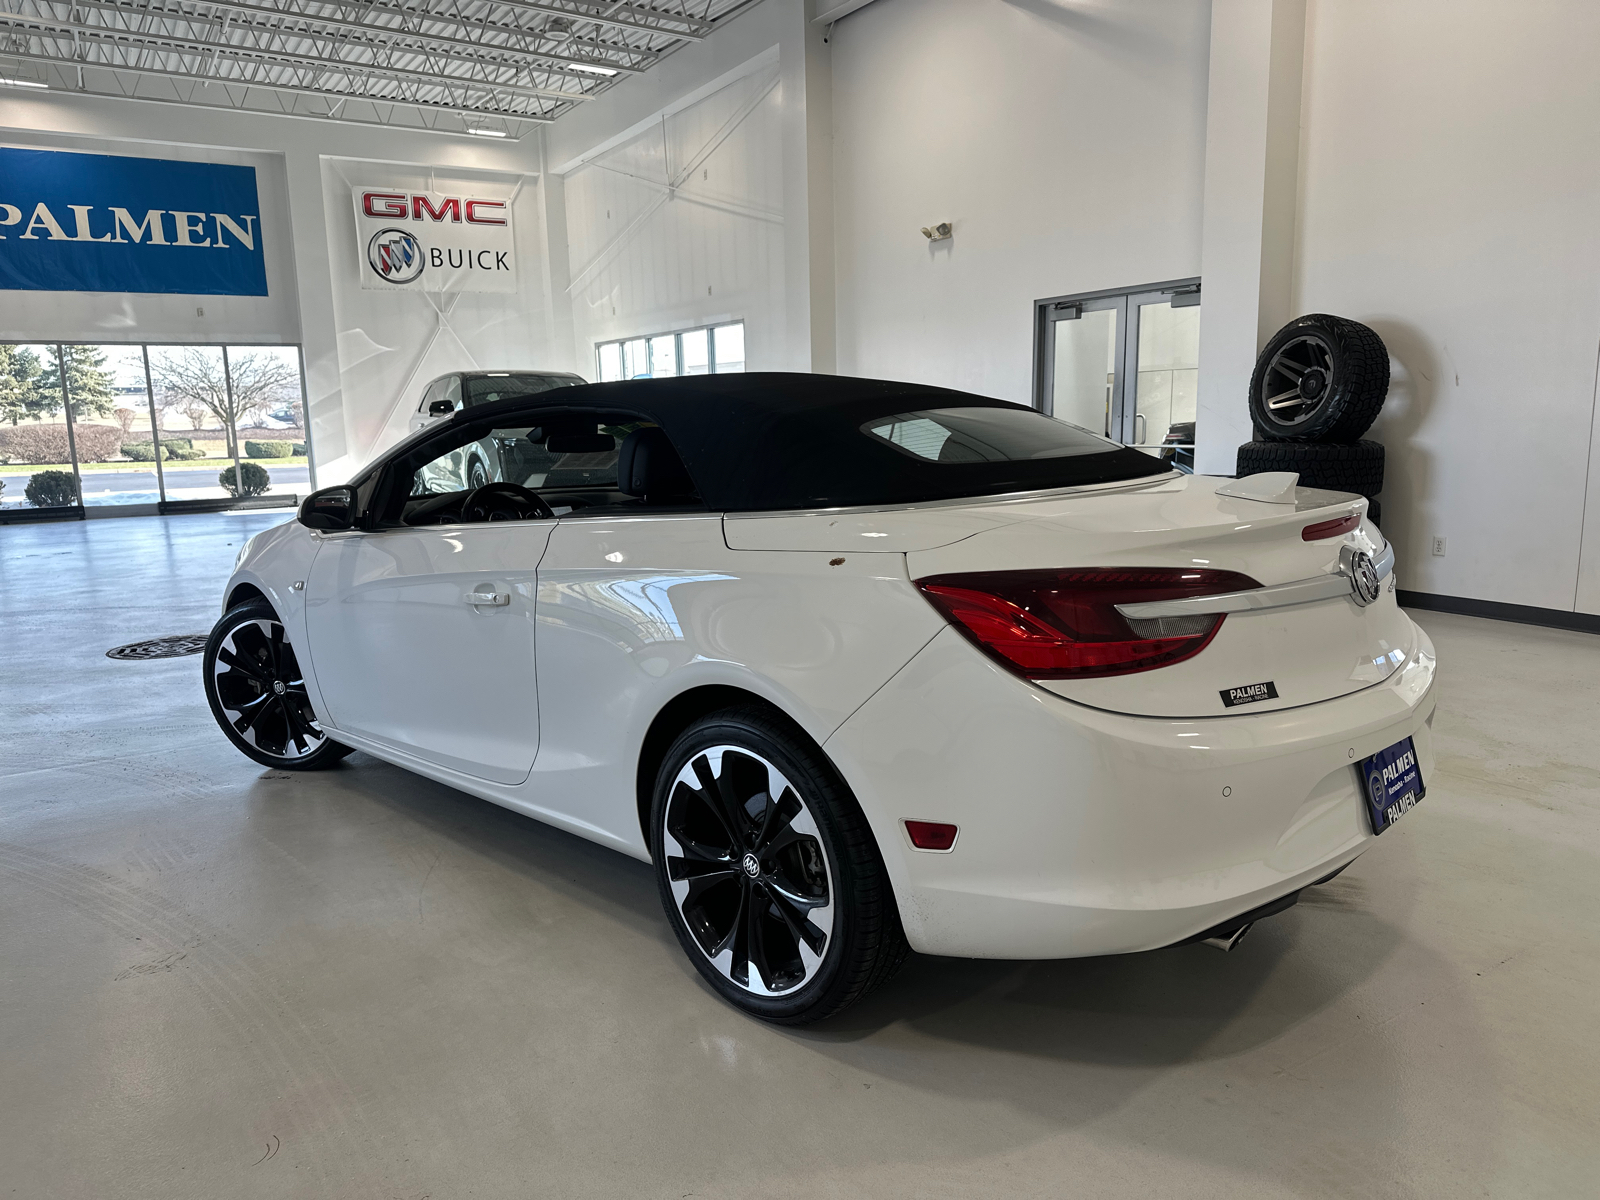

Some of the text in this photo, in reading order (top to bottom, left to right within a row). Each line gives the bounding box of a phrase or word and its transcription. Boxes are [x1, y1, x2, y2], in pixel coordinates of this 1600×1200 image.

[362, 191, 507, 227] GMC
[430, 247, 510, 271] BUICK
[1230, 684, 1268, 700] PALMEN
[1382, 749, 1415, 786] PALMEN
[1388, 781, 1404, 795] Kenosha
[1404, 771, 1416, 784] Racine
[1387, 790, 1416, 825] PALMEN
